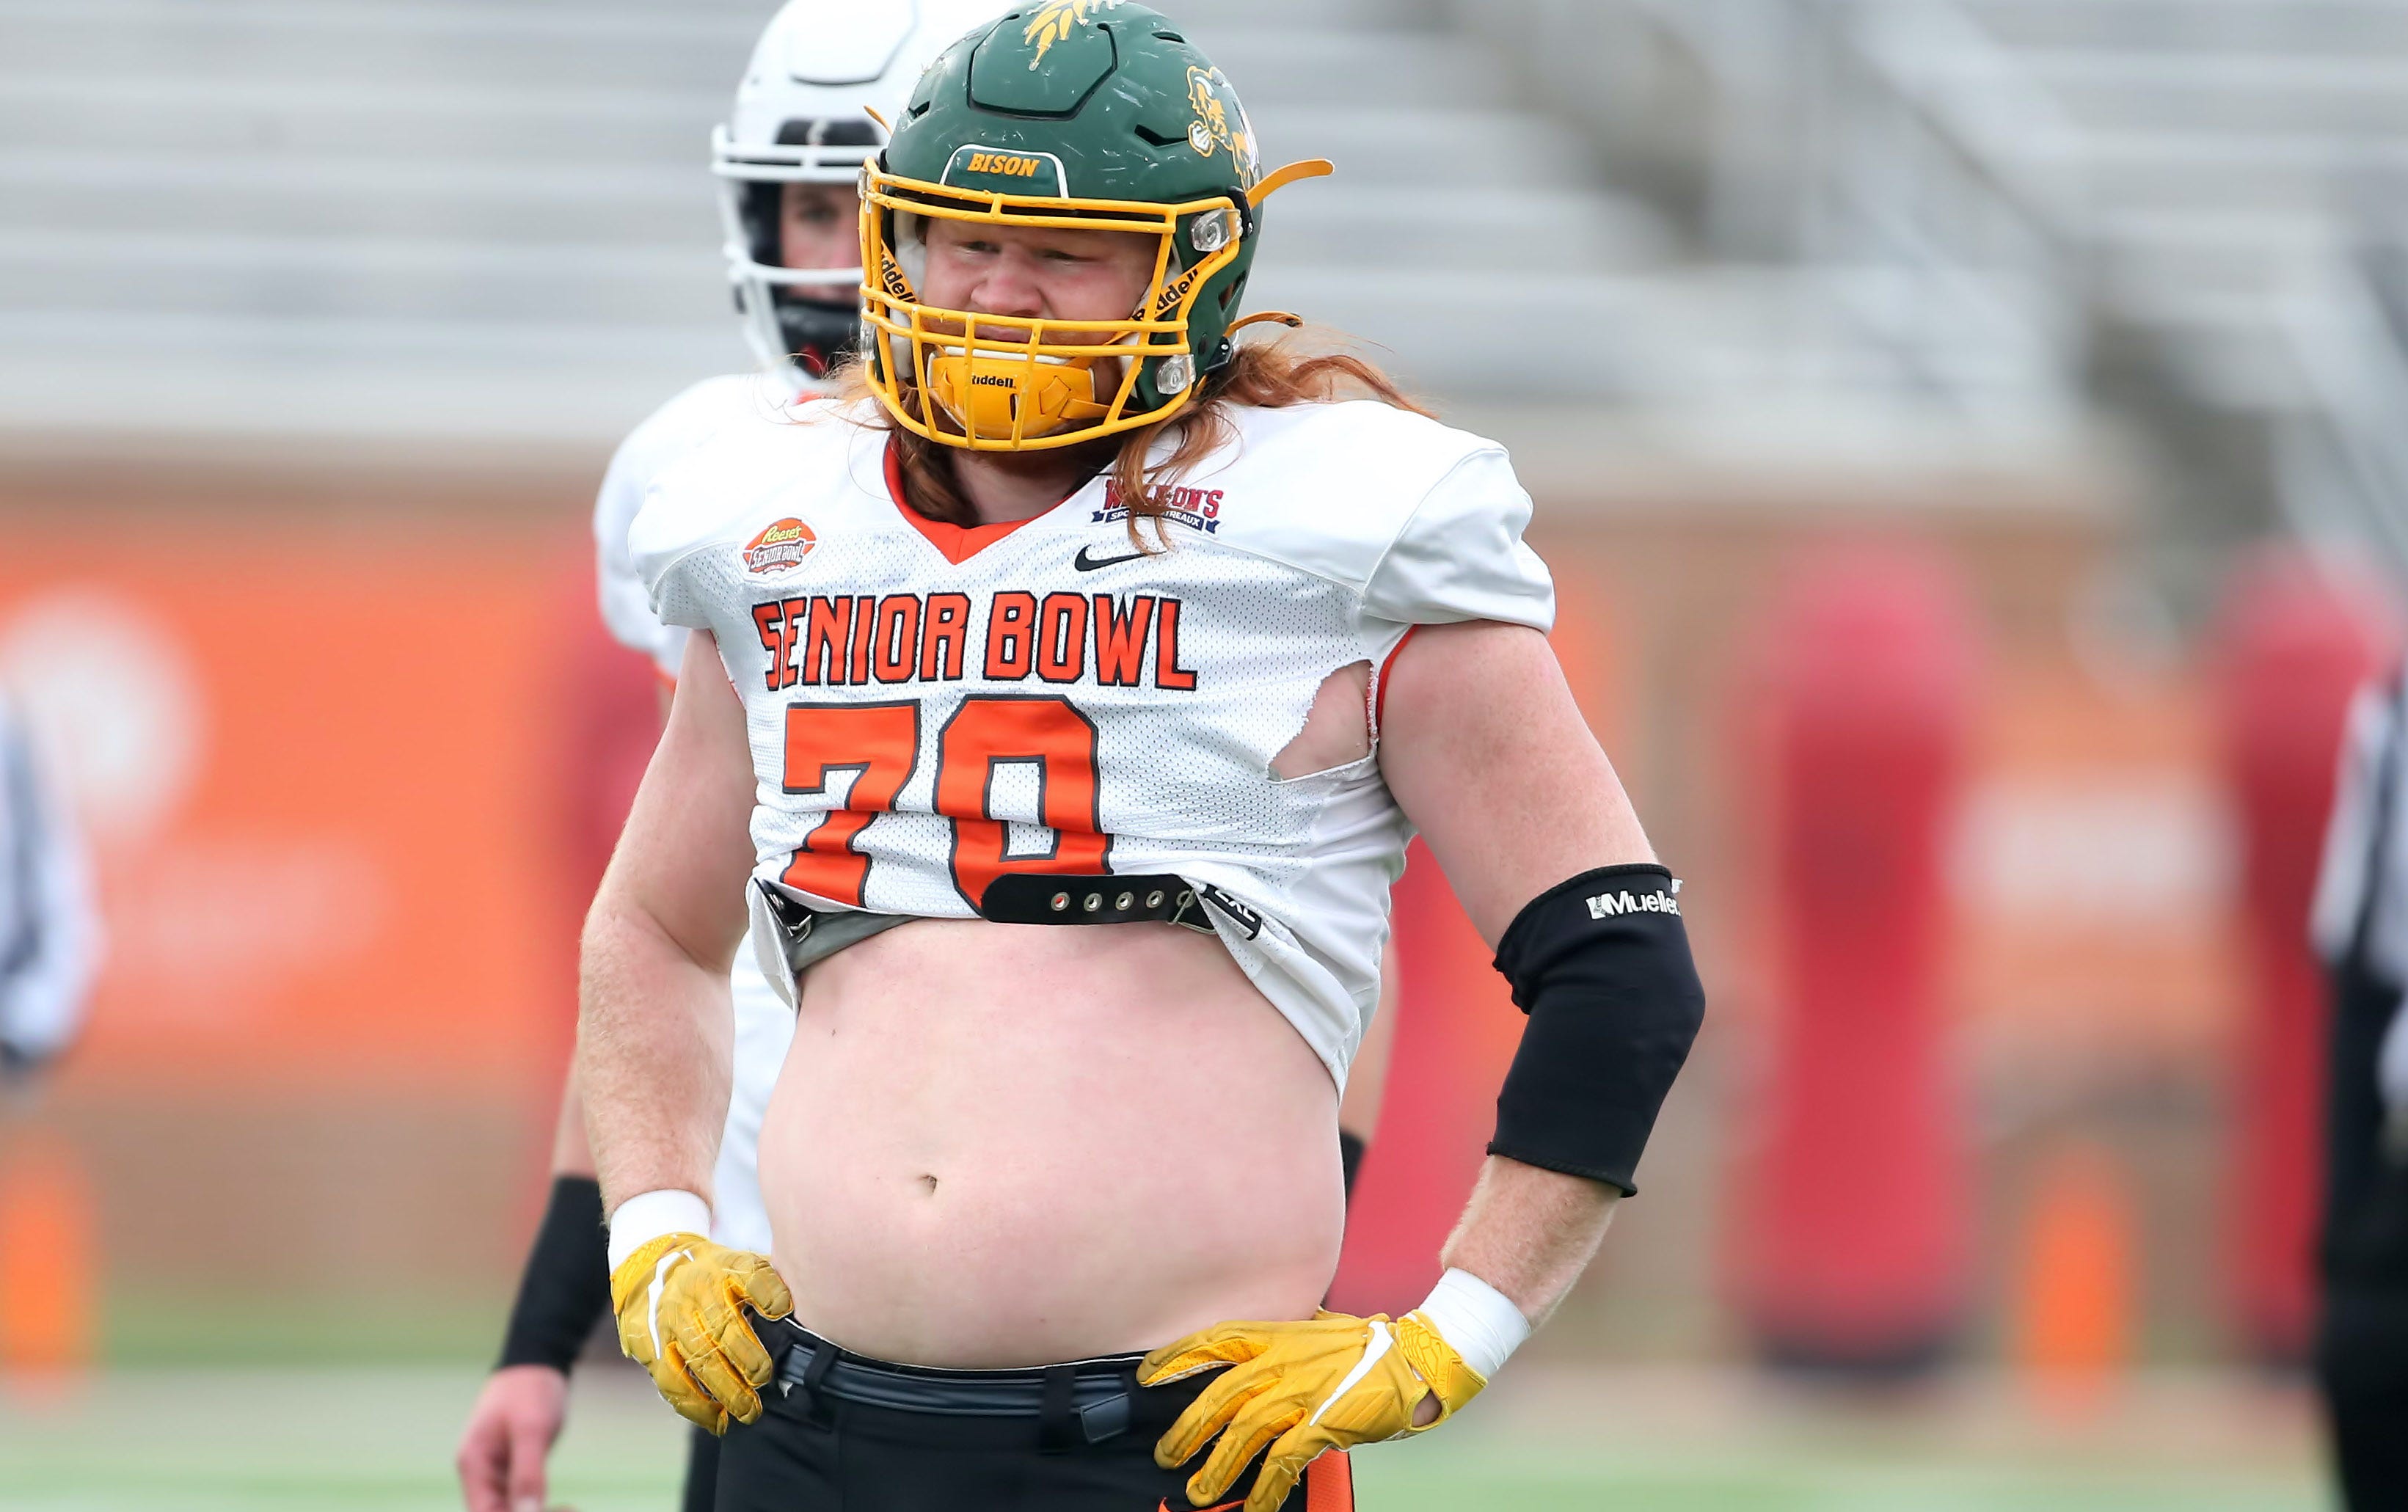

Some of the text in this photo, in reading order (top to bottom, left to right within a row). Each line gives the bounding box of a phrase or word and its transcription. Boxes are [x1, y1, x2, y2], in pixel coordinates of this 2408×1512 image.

[967, 153, 1040, 177] BISON
[880, 253, 916, 302] ddell
[1131, 269, 1198, 321] Rddel
[761, 525, 802, 544] Reese's
[1160, 511, 1200, 527] TREAUX
[751, 547, 783, 569] SENIOR
[782, 542, 804, 563] BOWL
[752, 591, 1197, 691] SENIOR BOWL
[782, 693, 1114, 917] 70
